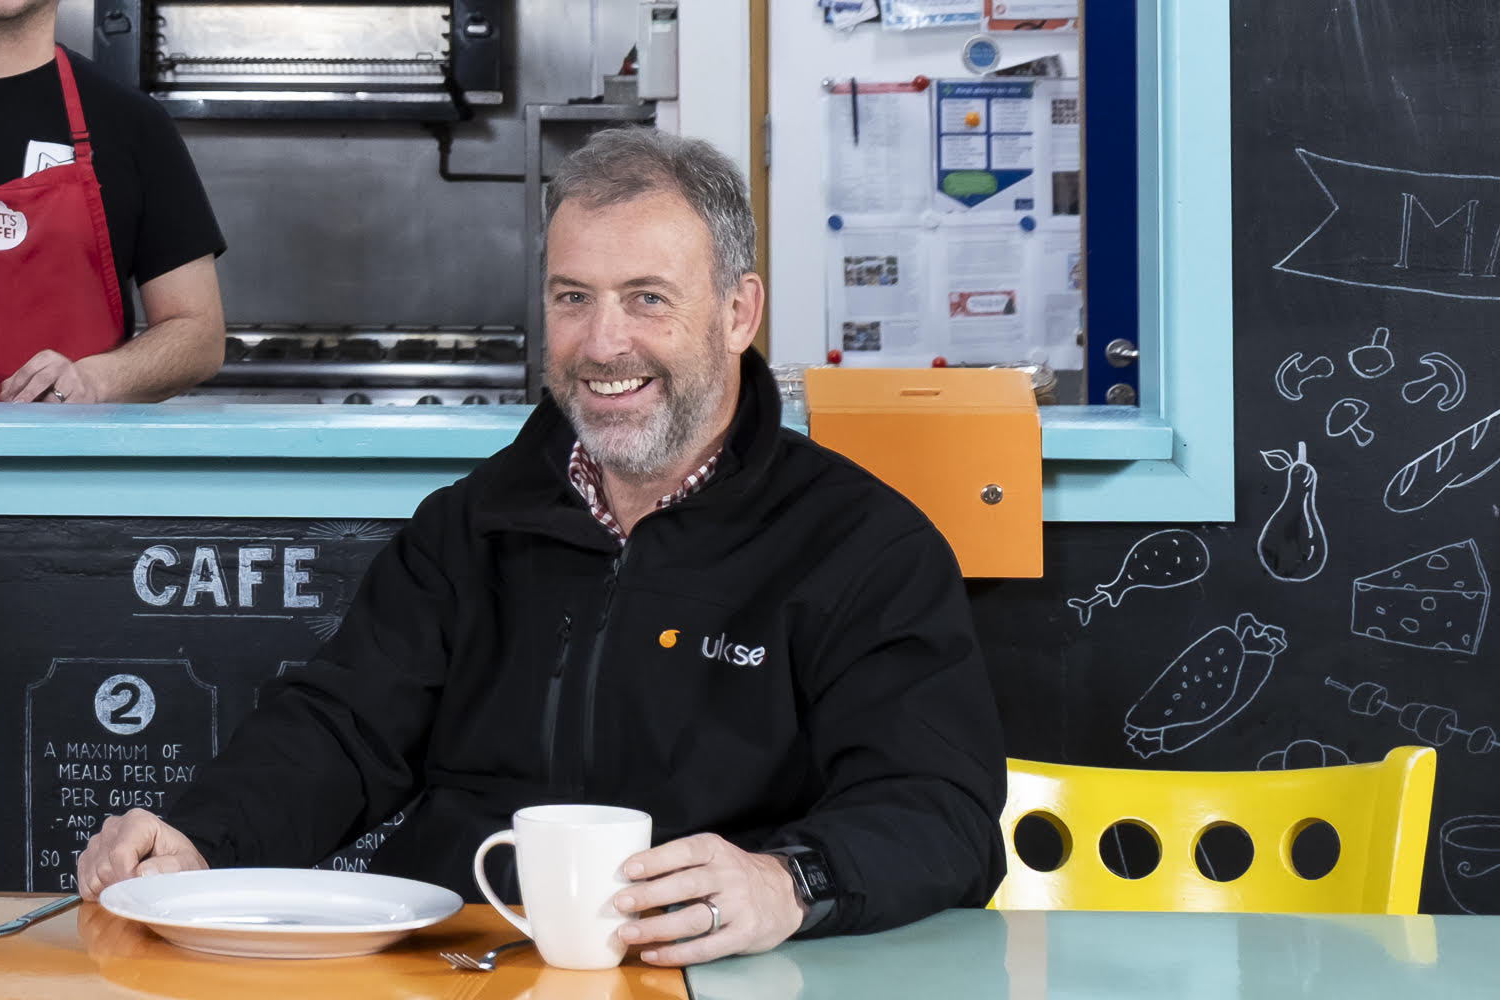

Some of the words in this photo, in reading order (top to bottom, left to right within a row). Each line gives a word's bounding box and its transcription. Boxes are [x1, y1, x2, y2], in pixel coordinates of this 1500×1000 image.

[132, 543, 322, 610] CAFE
[110, 681, 142, 725] 2
[44, 741, 56, 758] A
[66, 742, 148, 760] MAXIMUM
[162, 743, 183, 760] OF
[59, 764, 112, 781] MEALS
[123, 765, 157, 783] PER
[164, 764, 196, 782] DAY
[61, 787, 99, 807] PER
[109, 788, 166, 808] GUEST
[40, 849, 61, 868] SO
